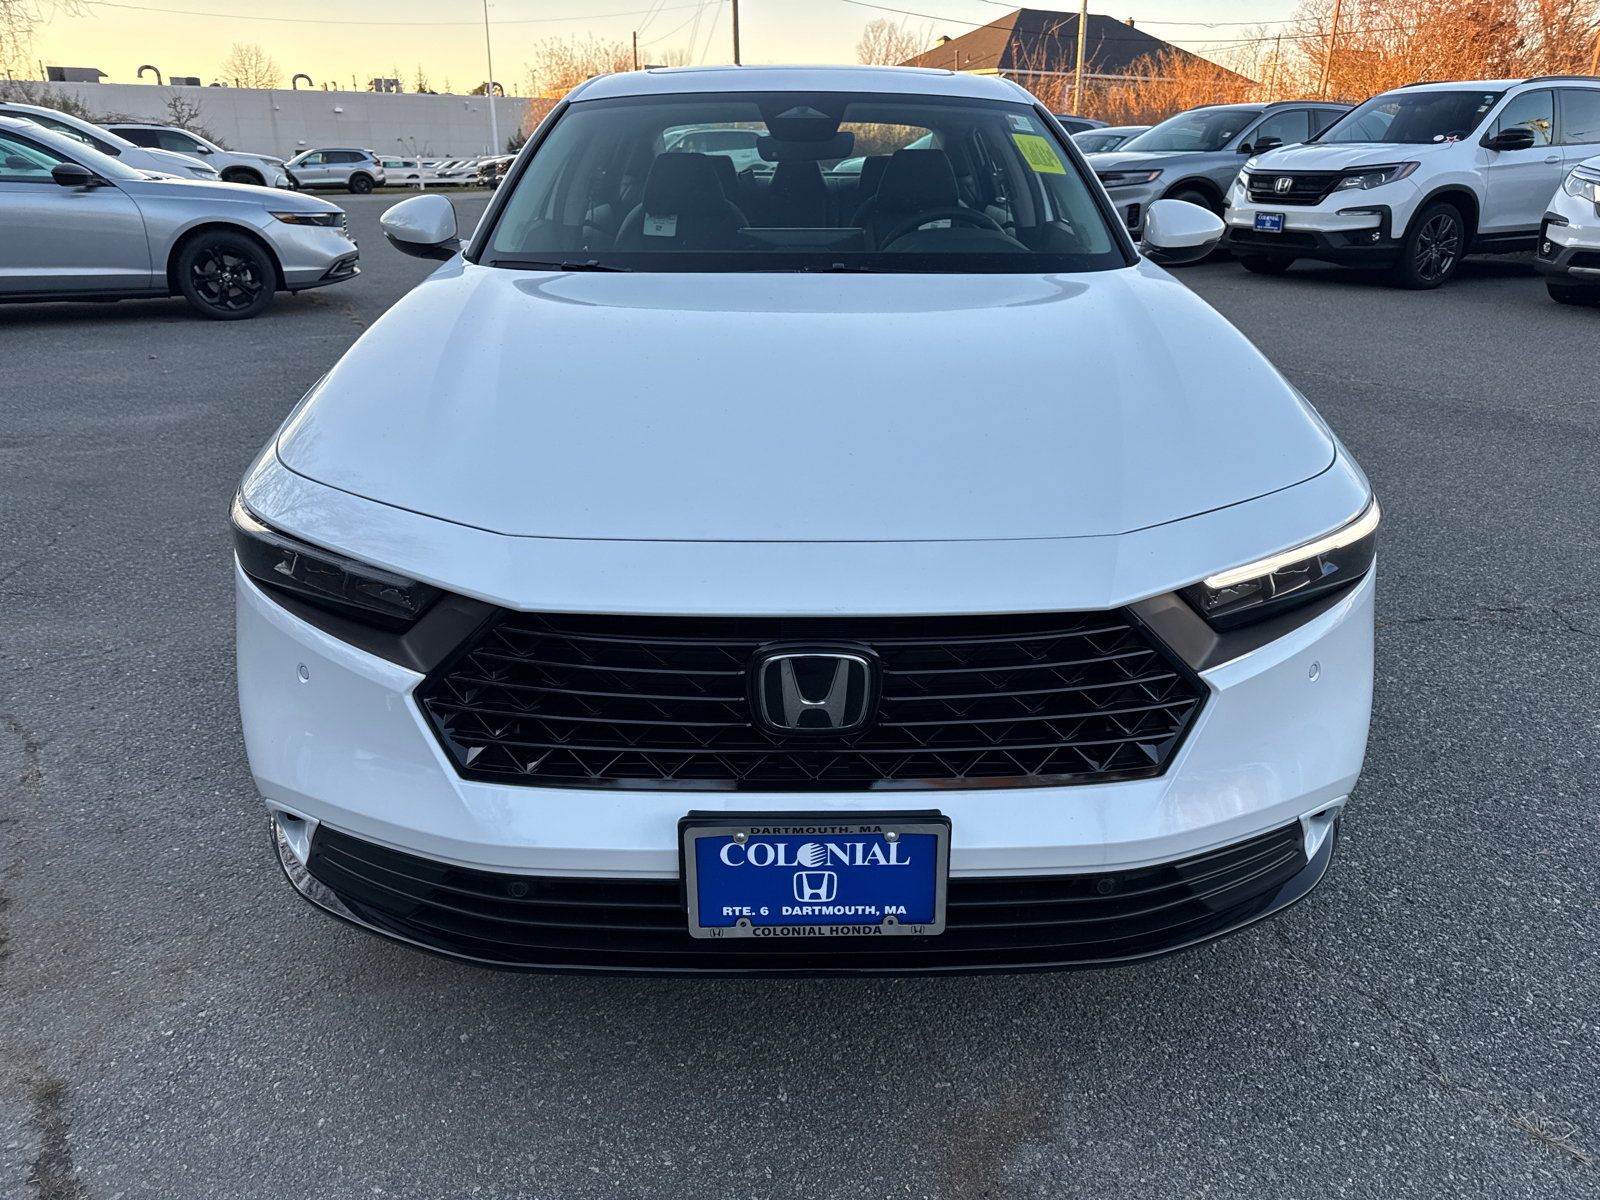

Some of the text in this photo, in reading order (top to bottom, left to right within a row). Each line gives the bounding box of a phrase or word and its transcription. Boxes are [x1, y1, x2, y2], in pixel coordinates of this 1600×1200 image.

[719, 842, 911, 868] COLONIAL
[722, 905, 907, 916] RTE. 6 DARTMOUTH, MA
[752, 925, 882, 937] COLONIAL HONDA
